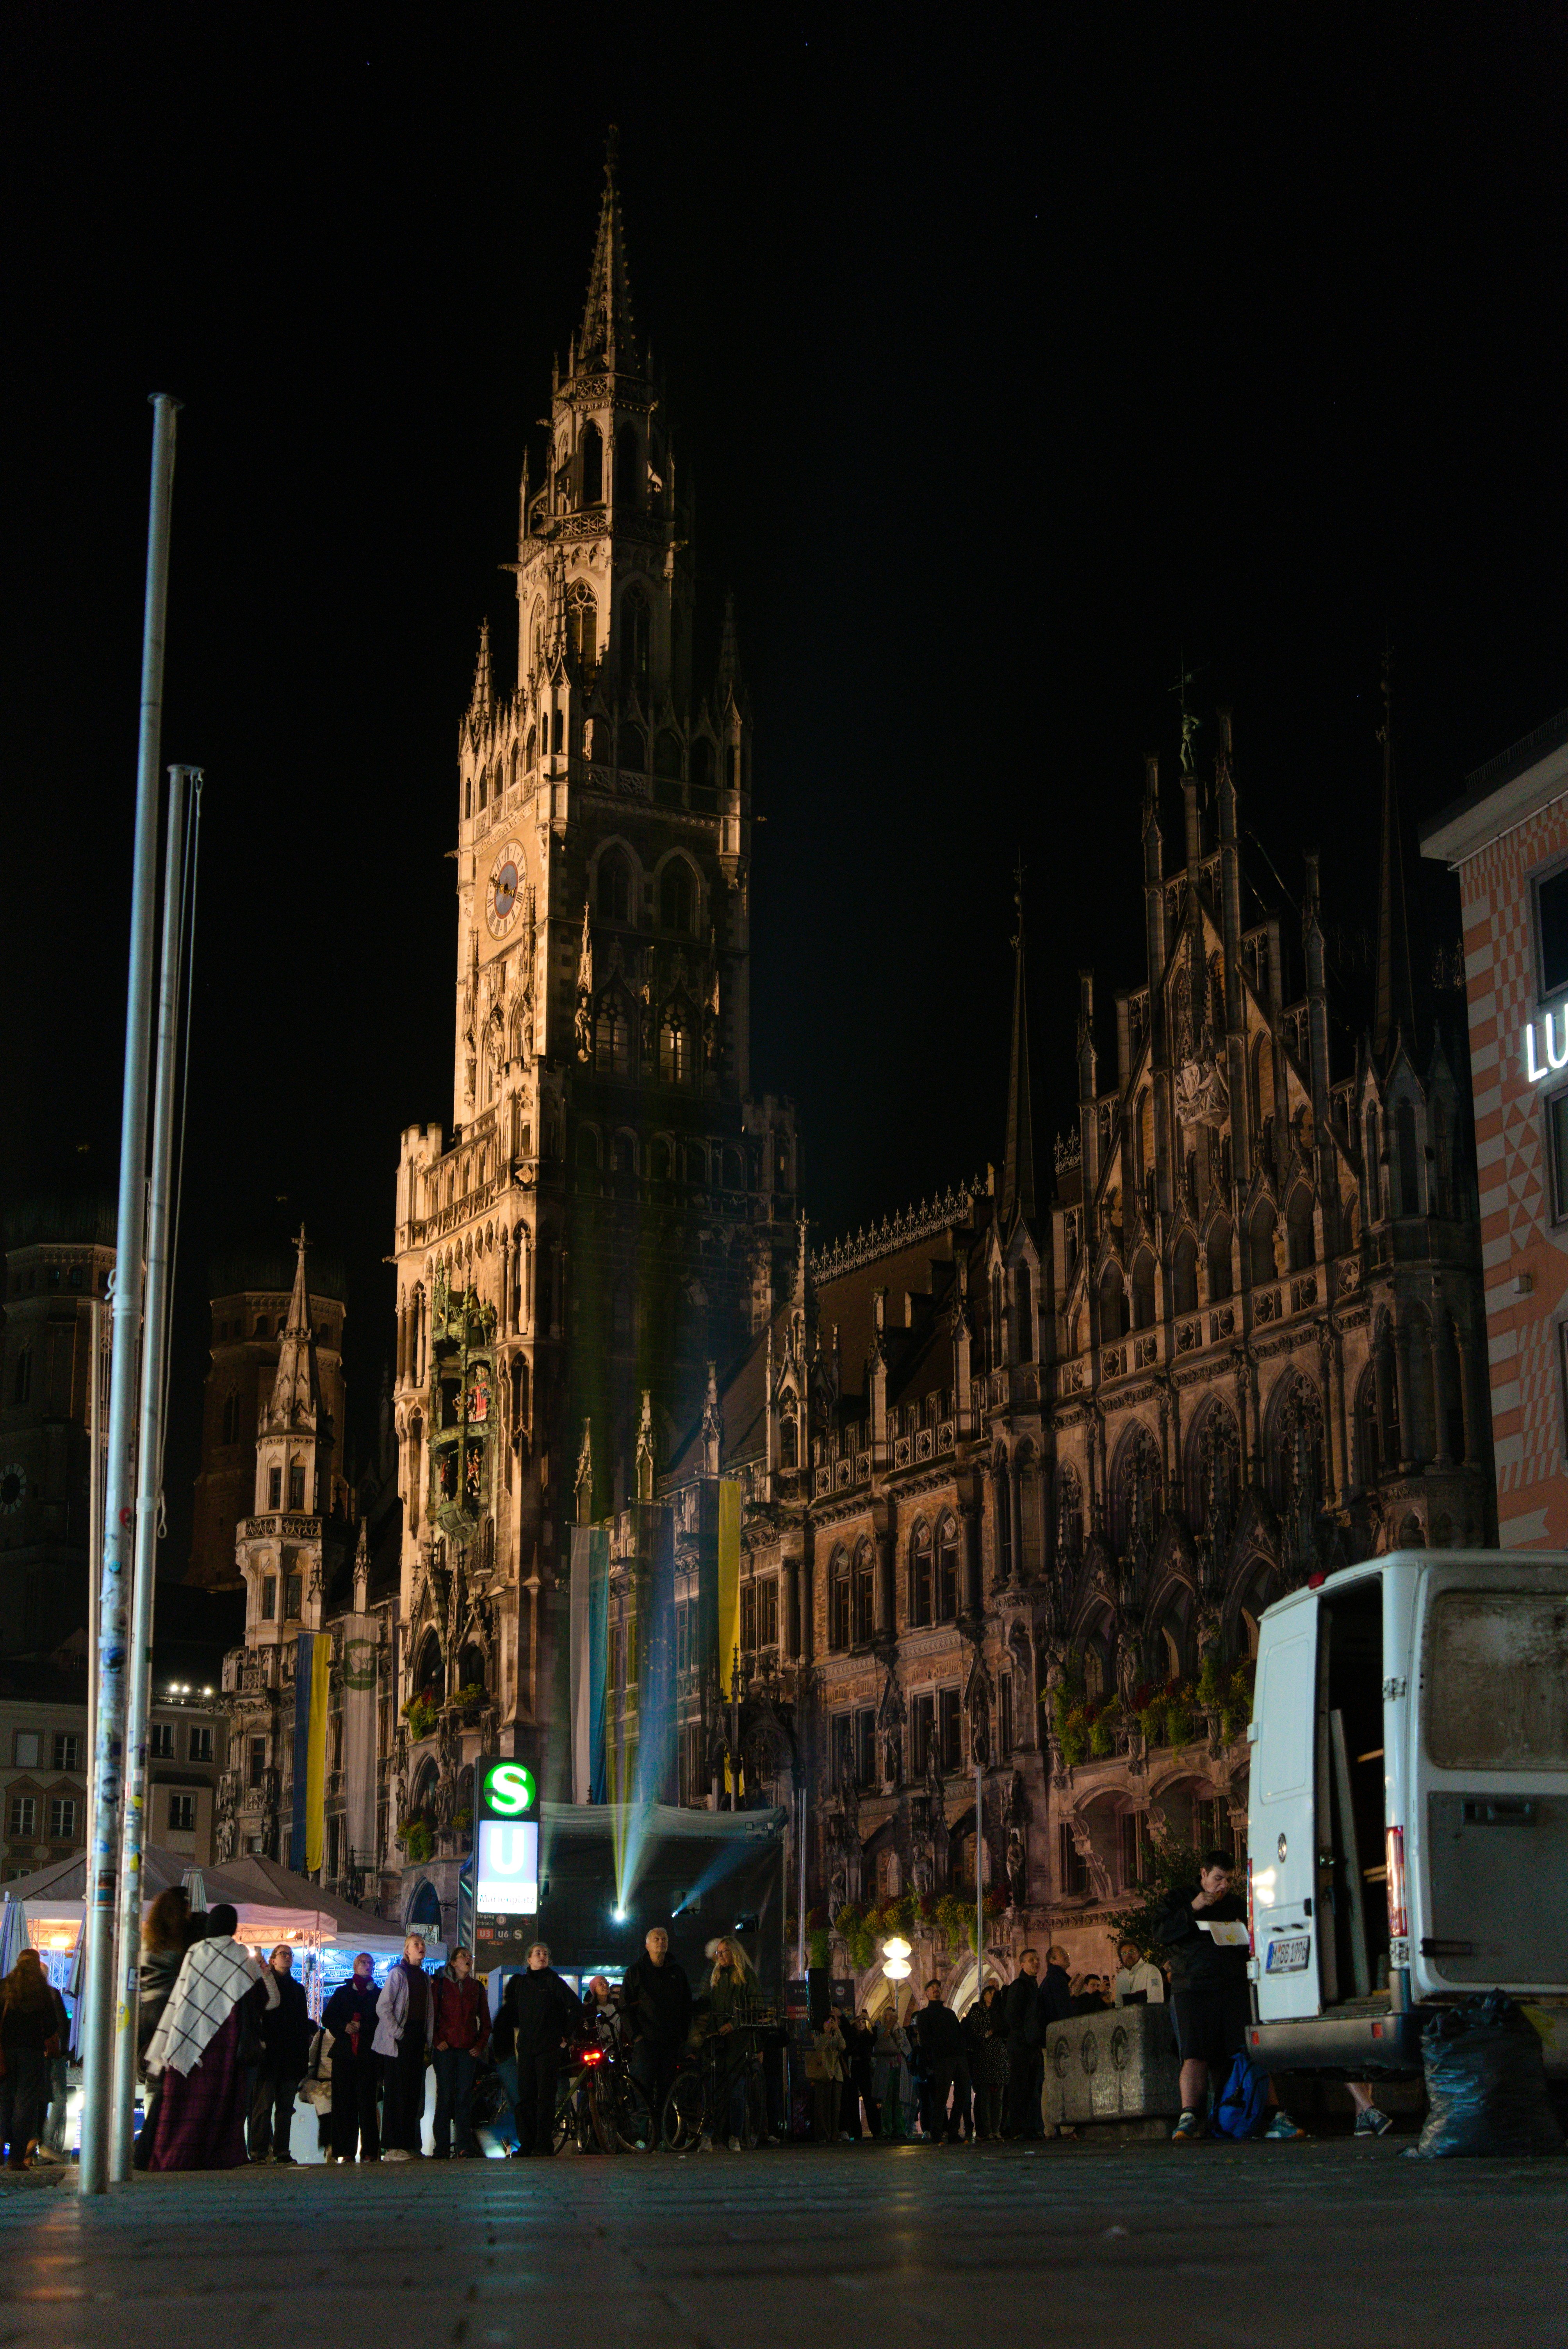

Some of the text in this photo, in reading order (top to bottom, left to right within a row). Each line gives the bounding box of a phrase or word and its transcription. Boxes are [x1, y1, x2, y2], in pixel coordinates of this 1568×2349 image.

[492, 1766, 528, 1813] S
[490, 1828, 525, 1875] U
[480, 1895, 534, 1905] Marienplatz
[514, 1930, 522, 1939] S
[1280, 1943, 1290, 1964] BB
[1290, 1941, 1306, 1962] 1996
